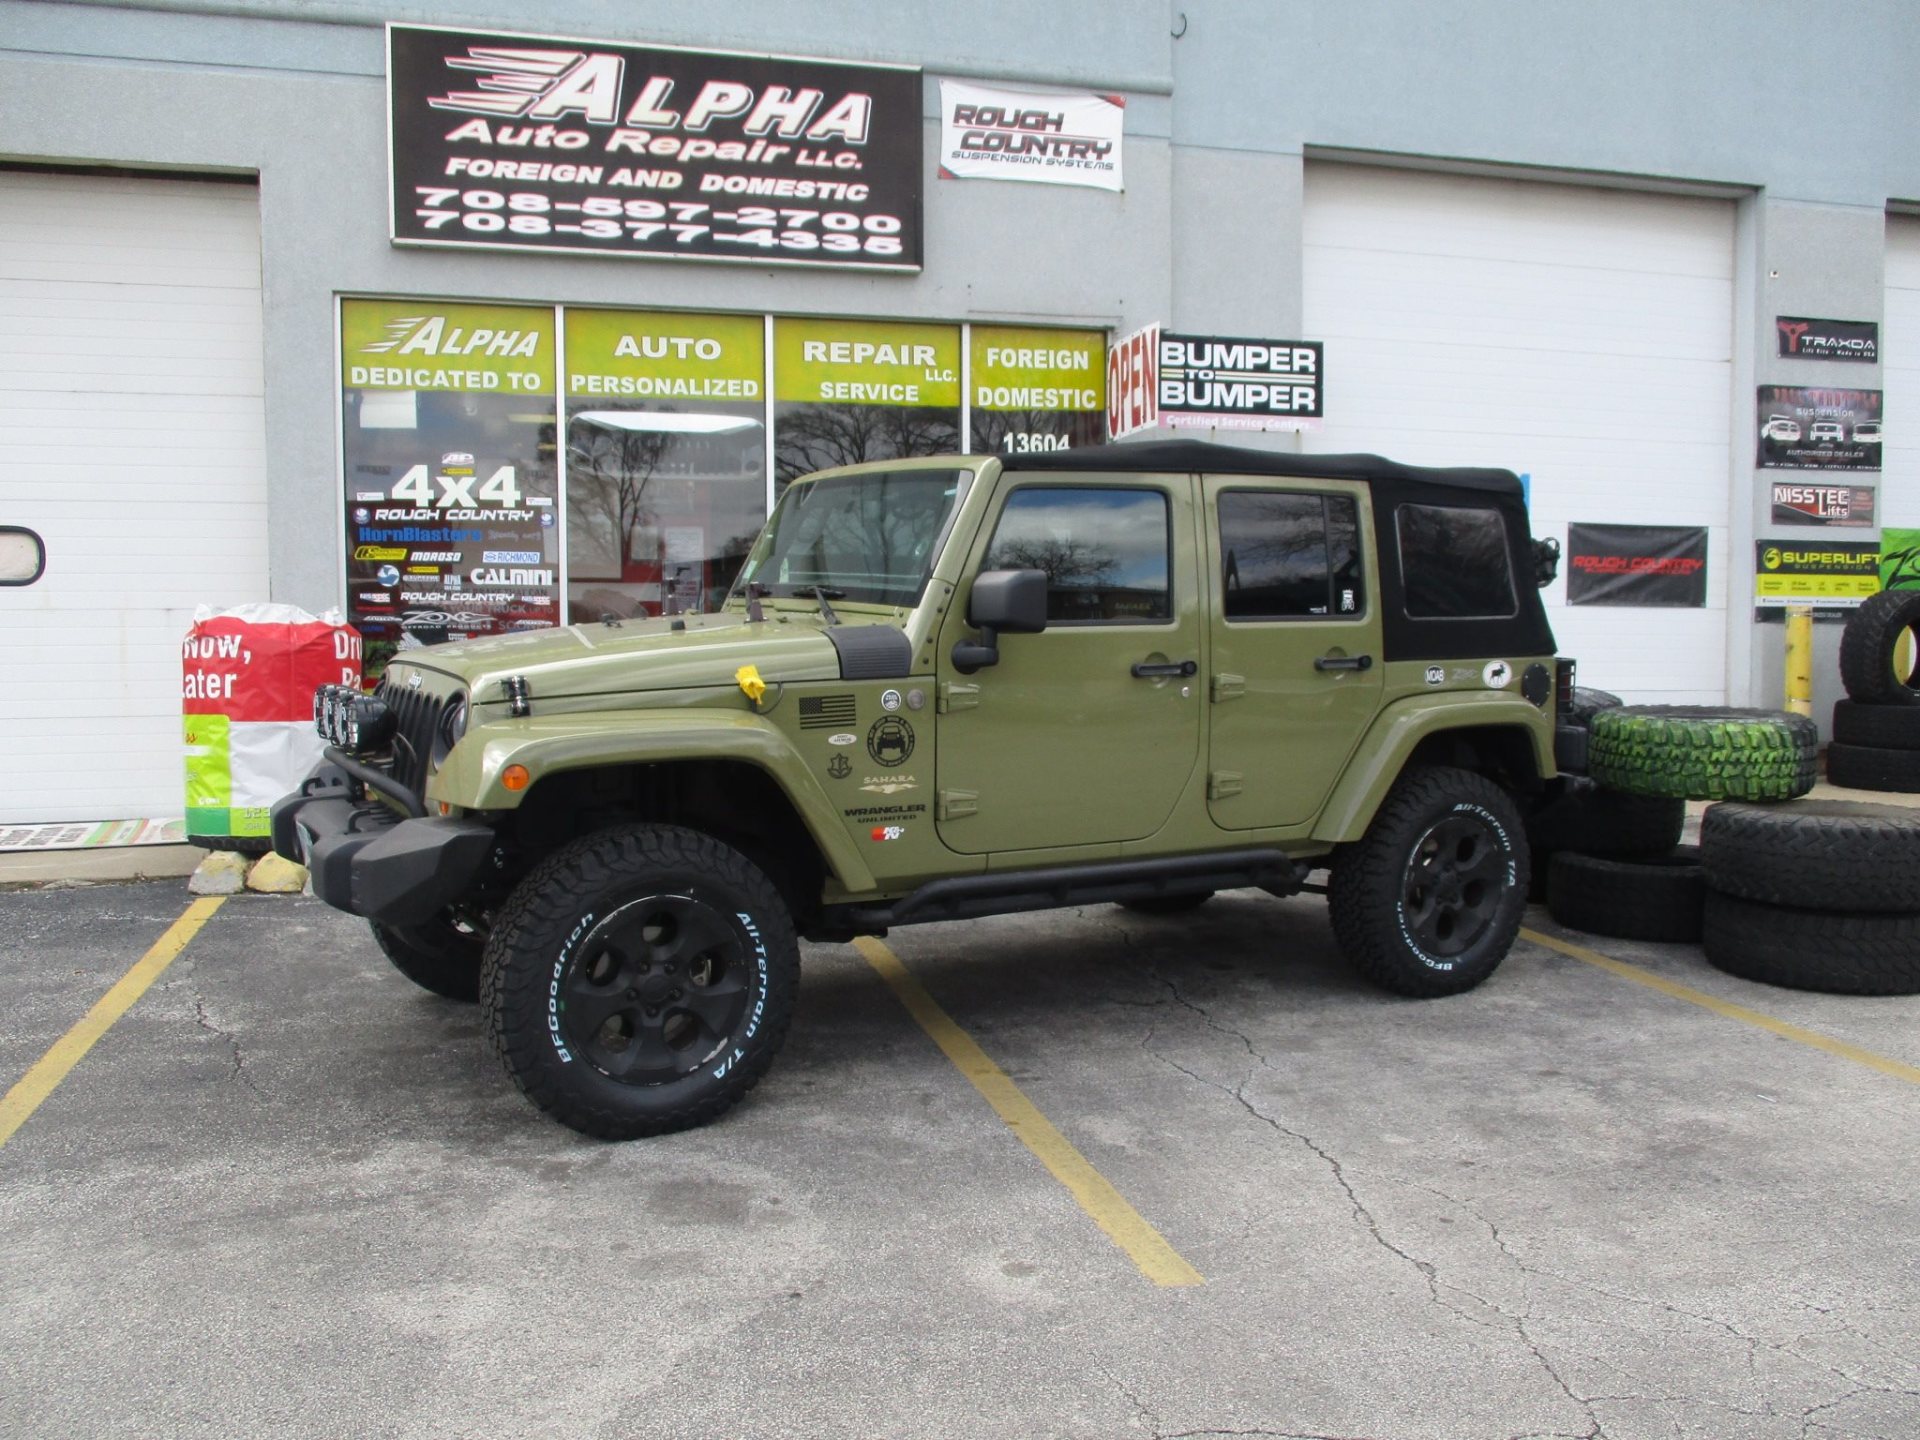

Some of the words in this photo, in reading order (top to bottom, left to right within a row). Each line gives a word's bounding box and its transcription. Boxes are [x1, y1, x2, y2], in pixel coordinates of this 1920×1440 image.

[530, 52, 872, 144] ALPHA
[953, 103, 1065, 132] ROUGH
[445, 119, 591, 149] Auto
[605, 129, 791, 163] Repair
[795, 149, 864, 170] LLC.
[960, 129, 1113, 161] COUNTRY
[951, 149, 1043, 165] SUSPENSION
[1045, 157, 1114, 171] SYSTEMS
[445, 156, 604, 186] FOREIGN
[607, 167, 684, 189] AND
[699, 173, 870, 202] DOMESTIC
[415, 186, 902, 234] 708-597-2700
[415, 209, 904, 255] 708-377-4335
[398, 316, 540, 358] ALPHA
[613, 334, 723, 361] AUTO
[1801, 335, 1875, 350] TRAXDA
[803, 340, 937, 367] REPAIR
[986, 347, 1090, 370] FOREIGN
[1160, 341, 1316, 373] BUMPER
[351, 366, 499, 389] DEDICATED
[507, 371, 541, 390] TO
[570, 374, 759, 397] PERSONALIZED
[925, 368, 957, 382] LLC.
[1107, 328, 1156, 438] OPEN
[1184, 368, 1216, 381] TO
[820, 381, 920, 402] SERVICE
[977, 386, 1097, 408] DOMESTIC
[1160, 380, 1316, 412] BUMPER
[1166, 414, 1219, 426] Certified
[1221, 416, 1264, 429] Service
[1003, 431, 1071, 453] 13604
[391, 464, 521, 508] 4x4
[1774, 487, 1849, 506] NISSTEC
[374, 508, 440, 520] ROUGH
[445, 509, 534, 521] COUNTRY
[359, 527, 483, 543] HornBlasters
[410, 551, 463, 562] MOROSO
[497, 551, 539, 563] RICHMOND
[1573, 555, 1627, 569] ROUGH
[1630, 556, 1704, 570] COUNTRY
[1782, 551, 1882, 565] SUPERLIFT
[470, 568, 553, 586] CALMINI
[400, 591, 447, 601] ROUGH
[450, 591, 515, 602] COUNTRY
[182, 668, 238, 699] ater
[863, 775, 916, 785] SAHARA
[844, 804, 926, 817] WRANGLER
[857, 814, 917, 824] UNLIMITED
[735, 912, 769, 1039] All-Terrain
[548, 912, 594, 1064] BFGoodrich
[712, 1047, 744, 1080] T/A
